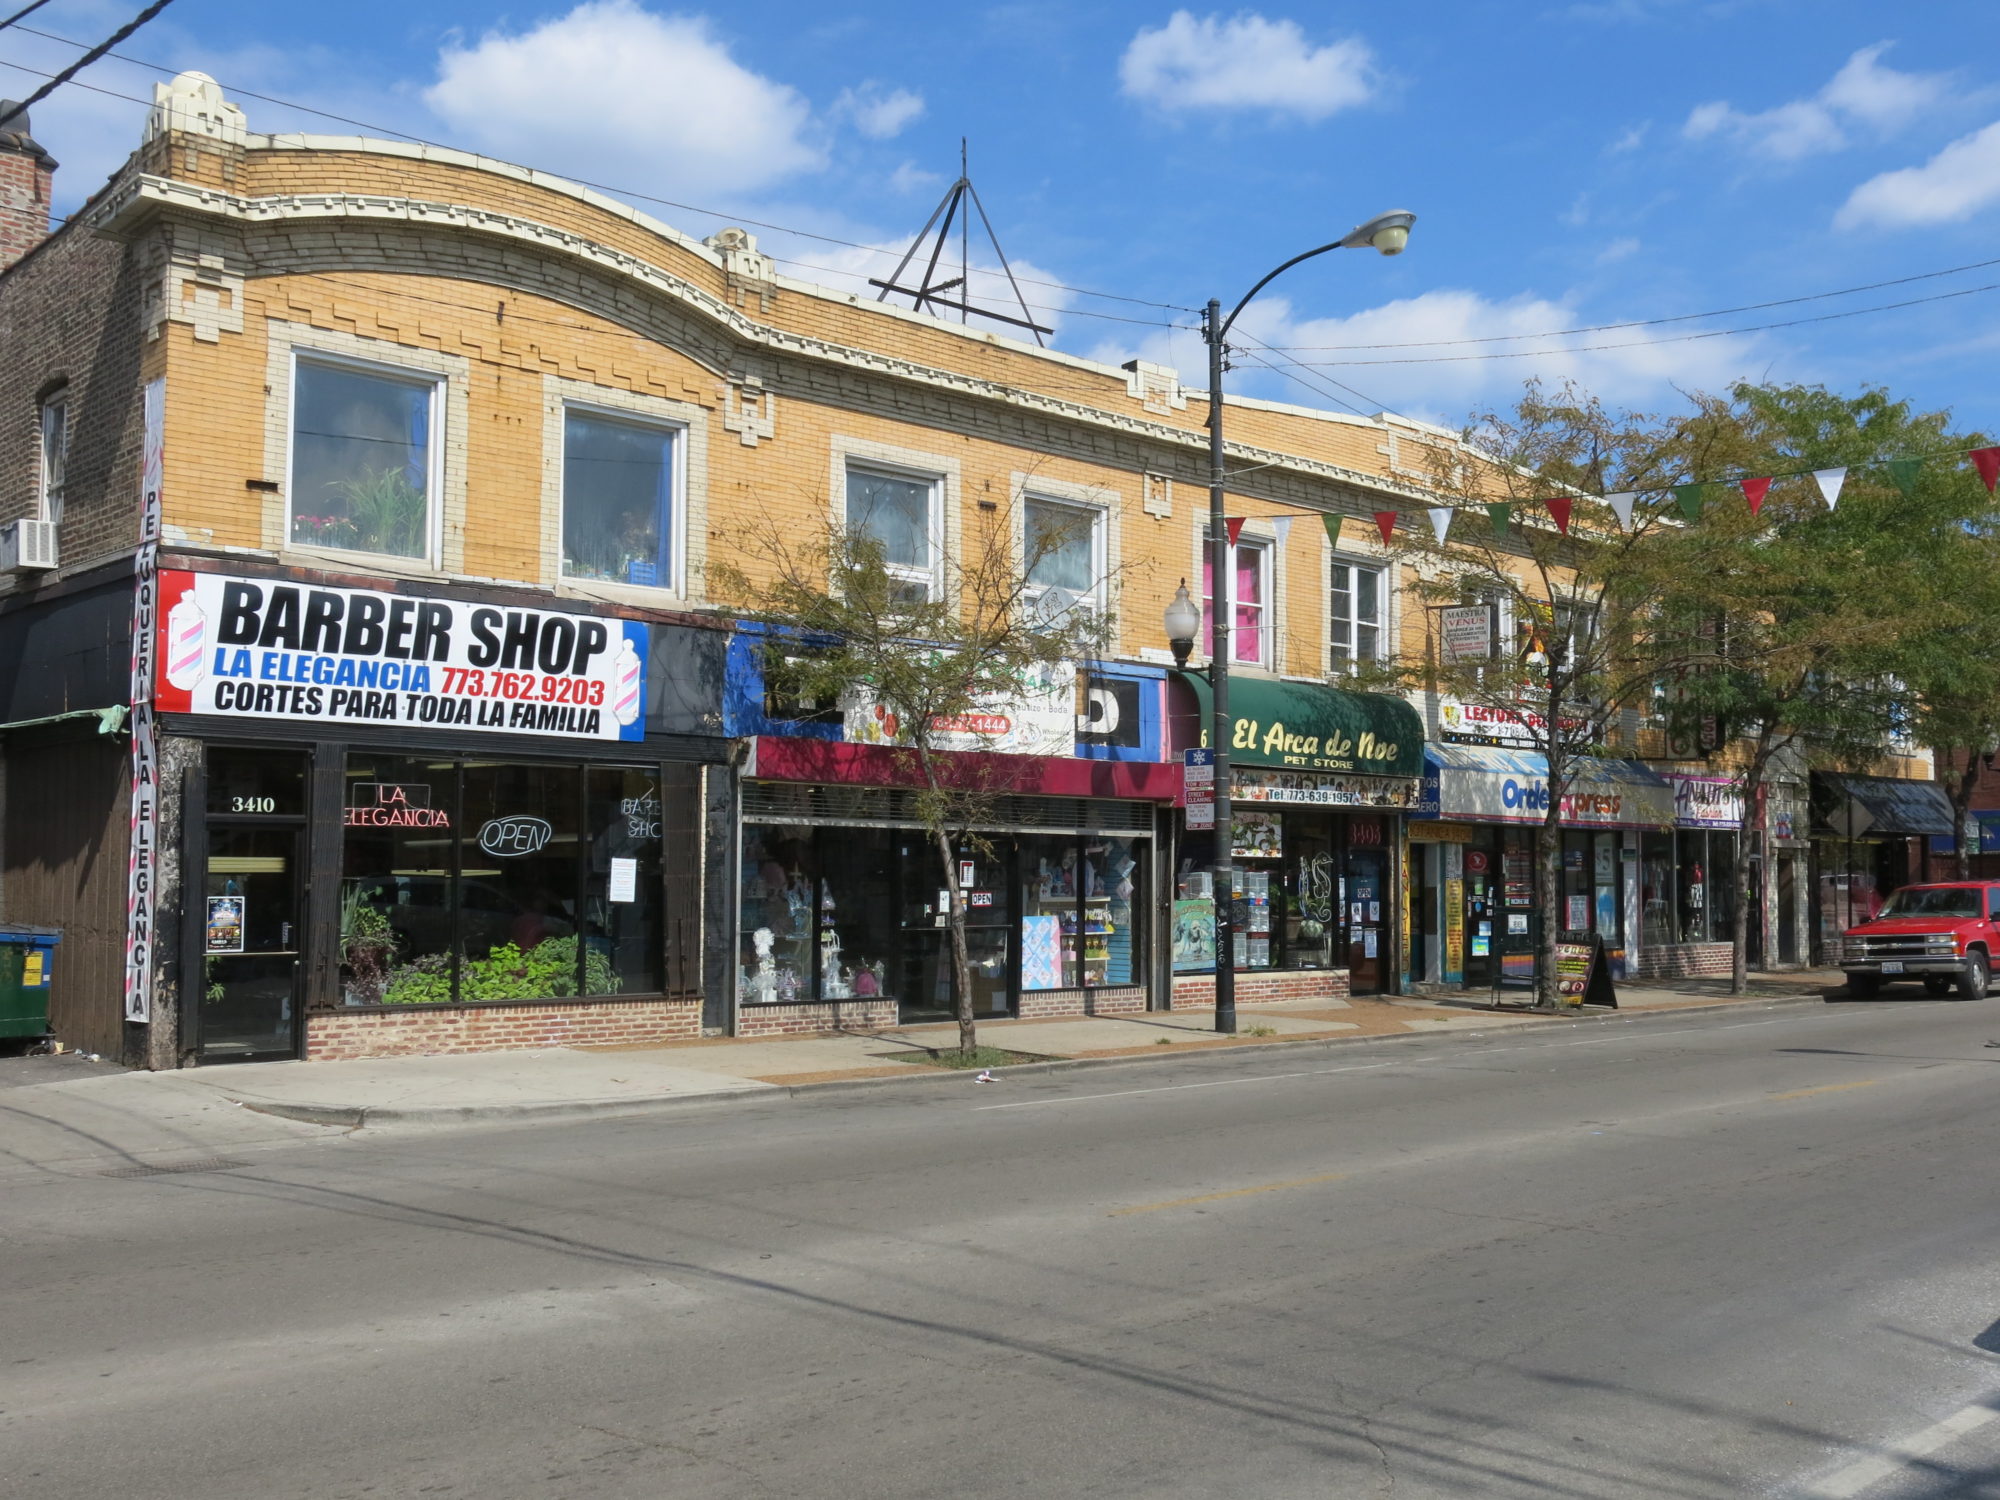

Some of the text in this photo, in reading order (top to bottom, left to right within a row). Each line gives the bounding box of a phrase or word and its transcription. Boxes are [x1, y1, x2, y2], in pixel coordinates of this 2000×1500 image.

[1446, 608, 1486, 619] MAESTRA
[1448, 616, 1486, 627] VENUS
[217, 581, 607, 676] BARBER SHOP
[213, 647, 430, 693] LA ELEGANCIA
[441, 667, 605, 706] 773.762.9203
[215, 681, 600, 734] CORTES PARA TODA LA FAMILIA
[1049, 703, 1068, 714] Boda
[1464, 705, 1523, 725] LECTURA
[1200, 730, 1207, 748] 6
[1232, 718, 1398, 761] El Arca de Noe
[139, 741, 151, 785] LA
[1284, 756, 1354, 769] PET STORE
[232, 796, 275, 813] 3410
[379, 785, 405, 804] LA
[1288, 789, 1354, 803] 773-639-1957
[1502, 779, 1550, 810] Orde
[344, 807, 450, 828] ELEGANCIA
[483, 821, 547, 851] OPEN
[132, 800, 150, 1016] ELEGANCIA
[973, 894, 991, 904] OPEN
